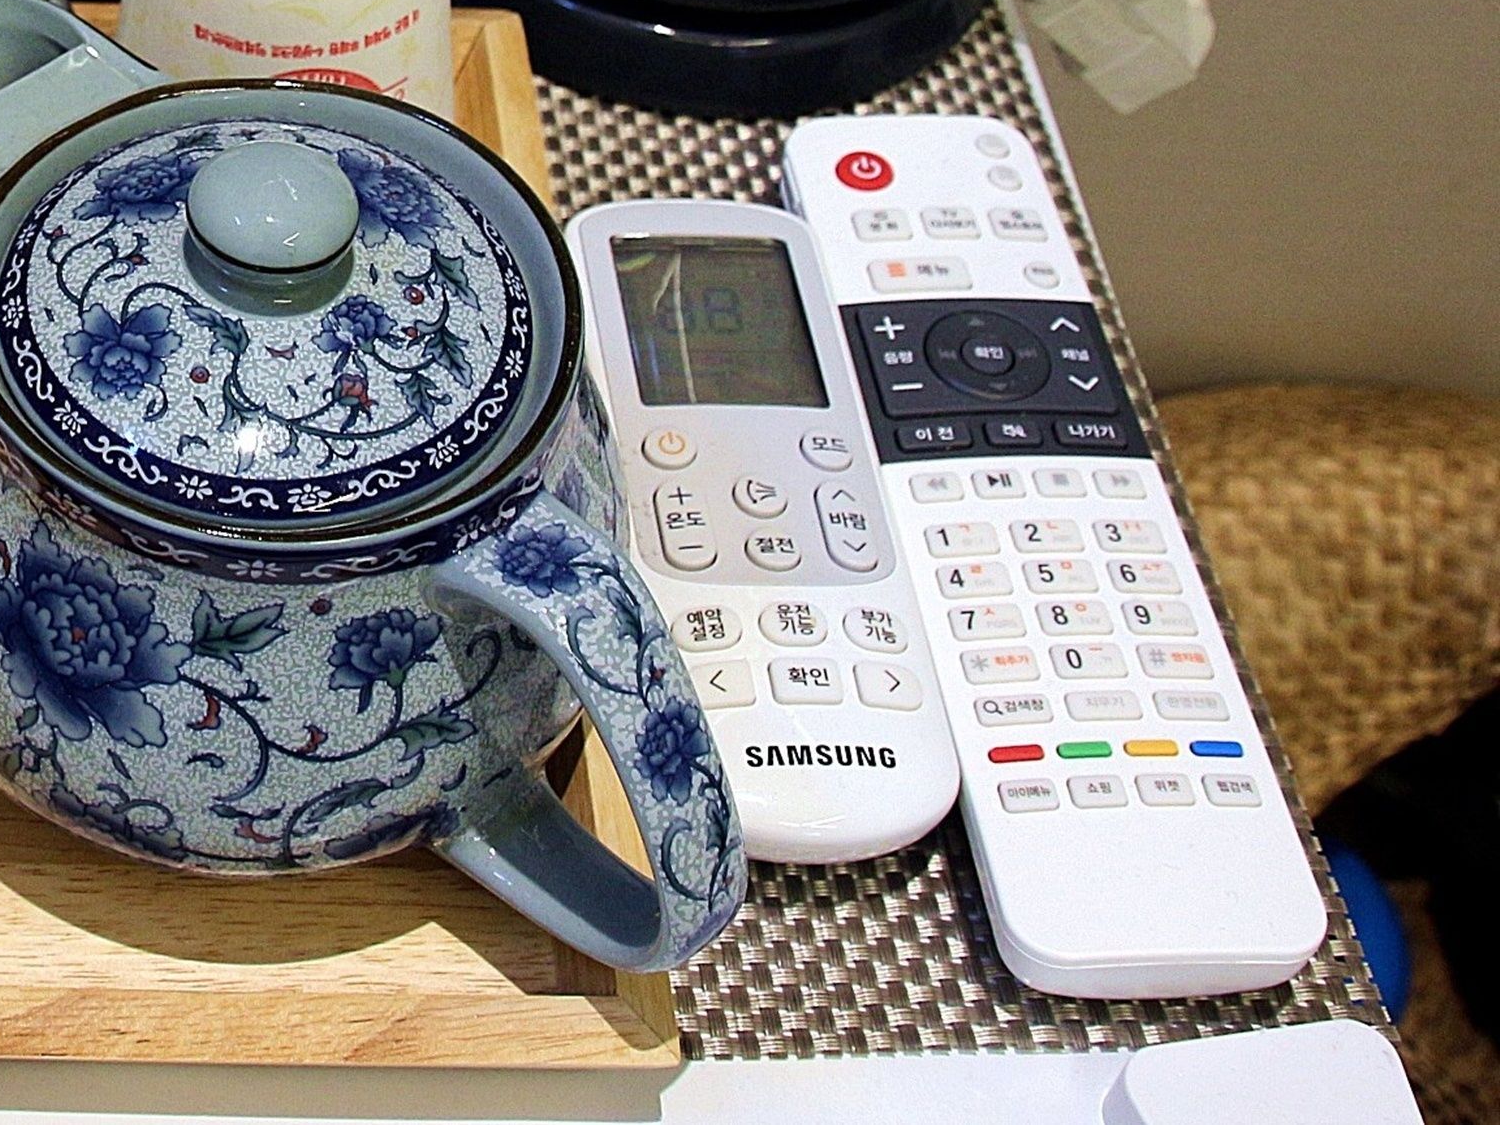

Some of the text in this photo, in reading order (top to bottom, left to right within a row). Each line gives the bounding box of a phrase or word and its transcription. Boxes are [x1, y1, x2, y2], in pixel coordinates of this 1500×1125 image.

[812, 437, 849, 453] 모드
[665, 511, 706, 527] 온도
[829, 512, 867, 531] 바람
[937, 528, 950, 547] 1
[1024, 524, 1042, 542] 2
[1107, 524, 1122, 542] 3
[755, 537, 795, 554] 절전
[949, 569, 965, 588] 4
[1038, 564, 1054, 583] 5
[1120, 564, 1136, 583] 6
[687, 608, 722, 625] 예약
[777, 604, 811, 618] 운전
[861, 609, 892, 627] 부가
[960, 610, 975, 630] 7
[1052, 606, 1068, 625] 8
[1134, 605, 1150, 624] 9
[691, 624, 725, 642] 설정
[781, 617, 814, 635] 기능
[866, 626, 897, 644] 기능
[1066, 649, 1083, 669] 0
[788, 667, 830, 687] 확인
[745, 744, 897, 769] SAMSUNG
